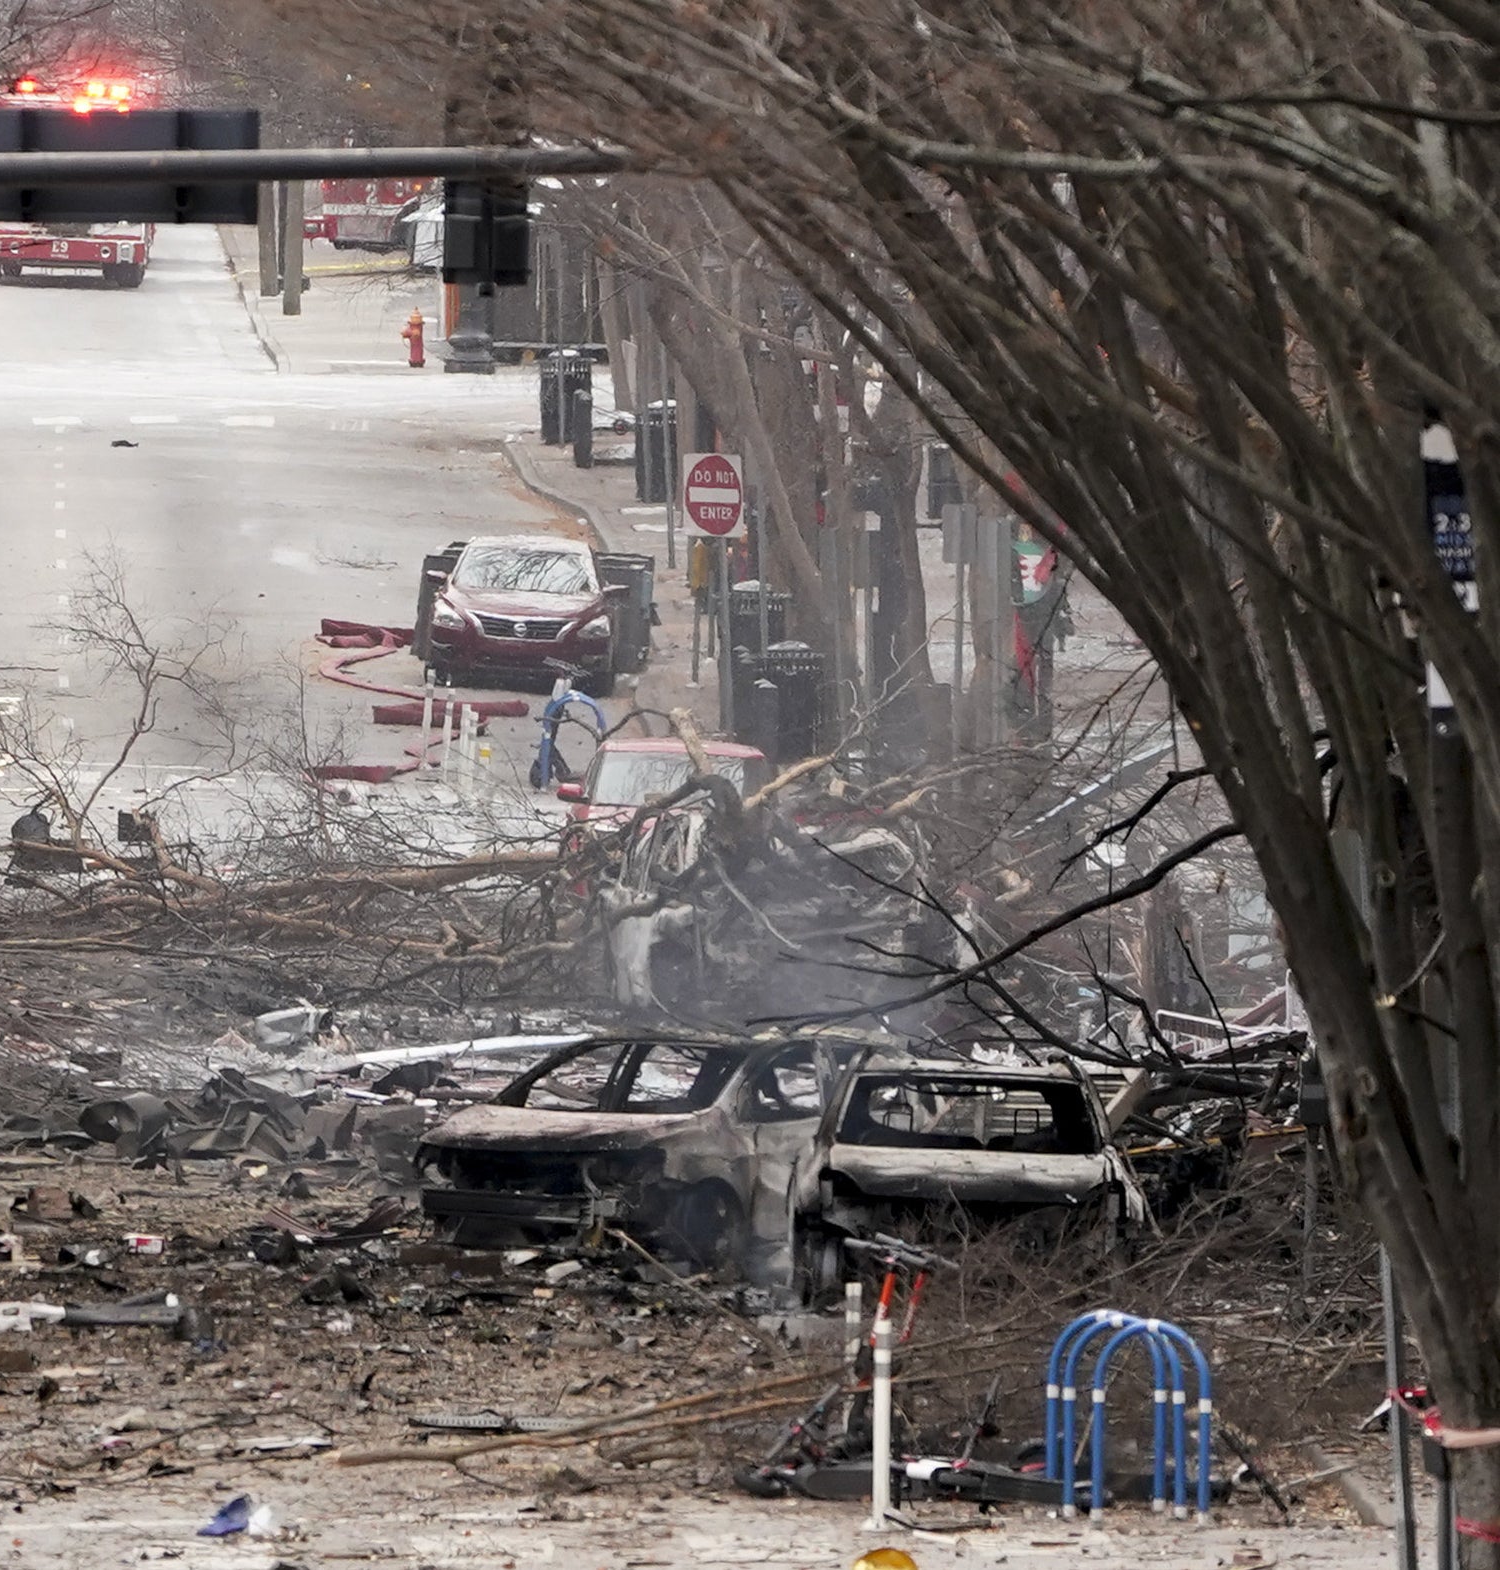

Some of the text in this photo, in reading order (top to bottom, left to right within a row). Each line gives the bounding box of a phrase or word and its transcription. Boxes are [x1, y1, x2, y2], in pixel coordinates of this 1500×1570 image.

[694, 470, 734, 484] DO NOT
[700, 506, 732, 519] ENTER
